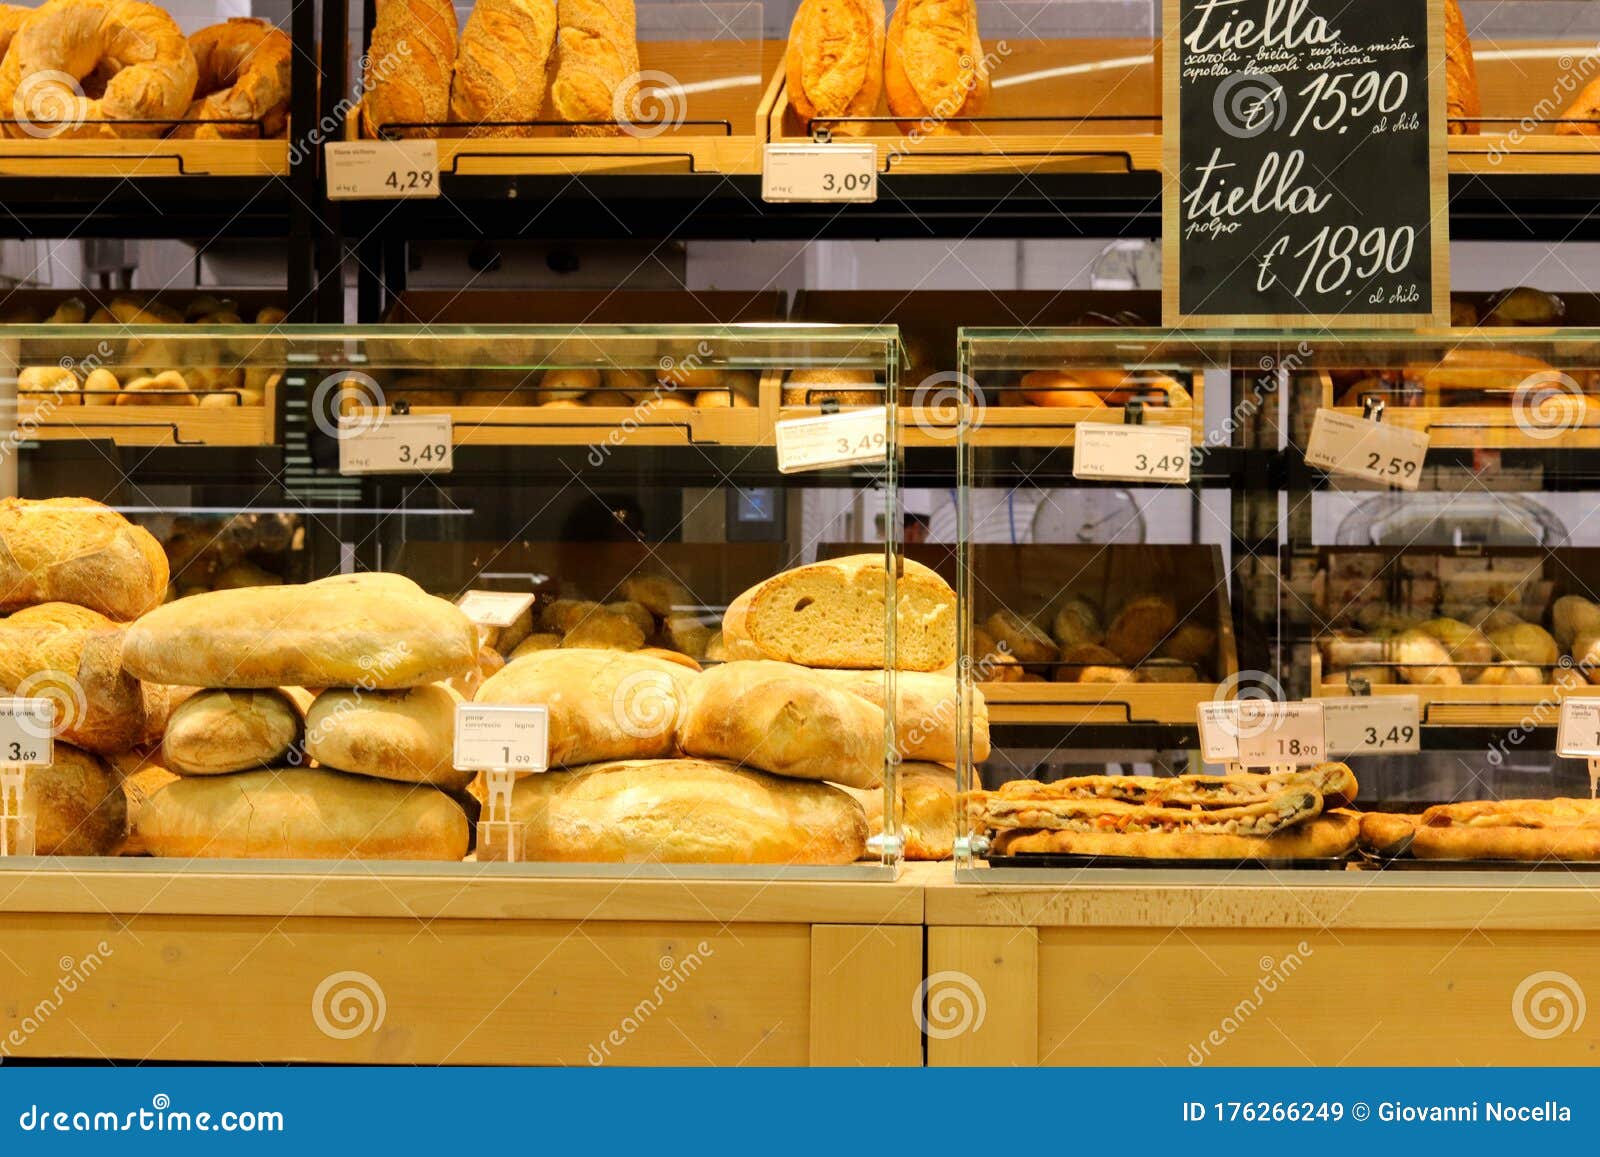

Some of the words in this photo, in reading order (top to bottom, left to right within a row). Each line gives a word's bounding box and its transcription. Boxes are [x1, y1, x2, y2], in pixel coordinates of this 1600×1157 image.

[1184, 0, 1341, 53] tiella
[1255, 44, 1294, 61] bieta
[1311, 41, 1364, 57] rustica
[1367, 35, 1415, 52] mista
[1372, 116, 1387, 134] al
[1392, 112, 1419, 132] chilo
[384, 170, 434, 193] 4,29
[822, 173, 872, 195] 3,09
[1182, 147, 1333, 220] tiella
[1185, 216, 1242, 241] polpo
[1369, 287, 1384, 304] al
[1389, 284, 1419, 304] chilo
[398, 444, 447, 465] 3,49
[836, 433, 886, 455] 3,49
[1135, 454, 1185, 475] 3,49
[1366, 452, 1417, 479] 2,59
[1364, 726, 1414, 748] 3,49
